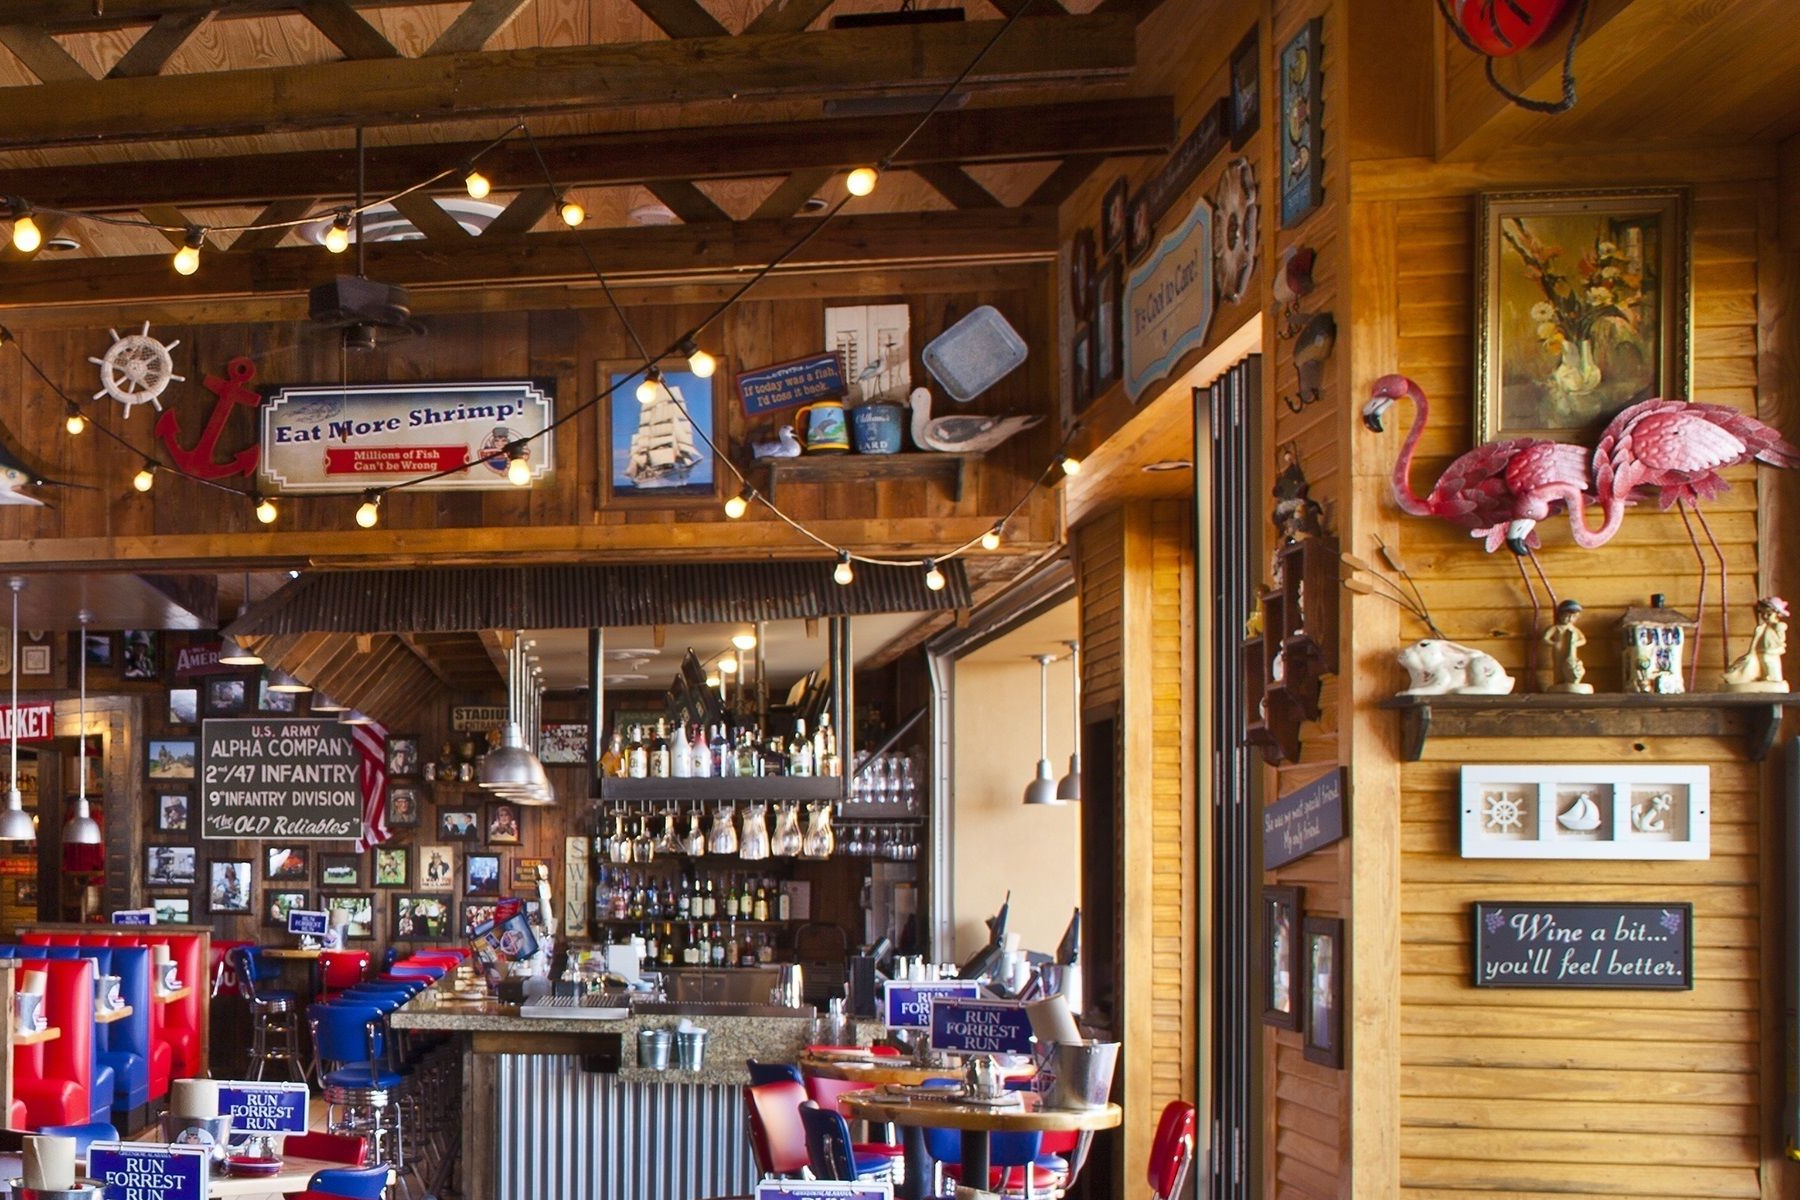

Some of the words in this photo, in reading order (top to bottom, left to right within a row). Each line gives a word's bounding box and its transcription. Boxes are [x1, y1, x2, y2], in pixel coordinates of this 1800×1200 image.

[743, 386, 753, 398] If
[755, 381, 784, 396] today
[785, 375, 805, 388] was
[772, 389, 793, 404] toss
[794, 388, 803, 400] it
[276, 426, 321, 443] Eat
[329, 418, 401, 440] More
[408, 400, 524, 427] Shrimp!
[353, 450, 400, 461] Millions
[402, 450, 415, 460] of
[415, 449, 440, 460] Fish
[353, 460, 384, 472] Can't
[386, 460, 400, 471] be
[401, 460, 437, 473] Wrong
[251, 725, 276, 738] U.S.
[281, 724, 321, 738] ARMY
[211, 739, 264, 758] ALPHA
[268, 738, 355, 757] COMPANY
[261, 763, 360, 784] INFANTRY
[225, 790, 287, 807] INFANTRY
[292, 790, 355, 807] DIVISION
[234, 815, 271, 834] OLD
[568, 834, 586, 922] SWIM
[1509, 913, 1584, 944] Wine
[1590, 926, 1606, 942] a
[1613, 915, 1668, 942] bit...
[1484, 948, 1552, 980] you'll
[1557, 947, 1602, 980] feel
[1607, 948, 1683, 977] better.
[964, 1010, 1001, 1024] RUN
[945, 1022, 1020, 1039] FORREST
[964, 1036, 1000, 1051] RUN
[246, 1093, 278, 1107] RUN
[230, 1105, 294, 1119] FORREST
[245, 1116, 278, 1131] RUN
[126, 1157, 165, 1175] RUN
[105, 1170, 187, 1191] FORREST
